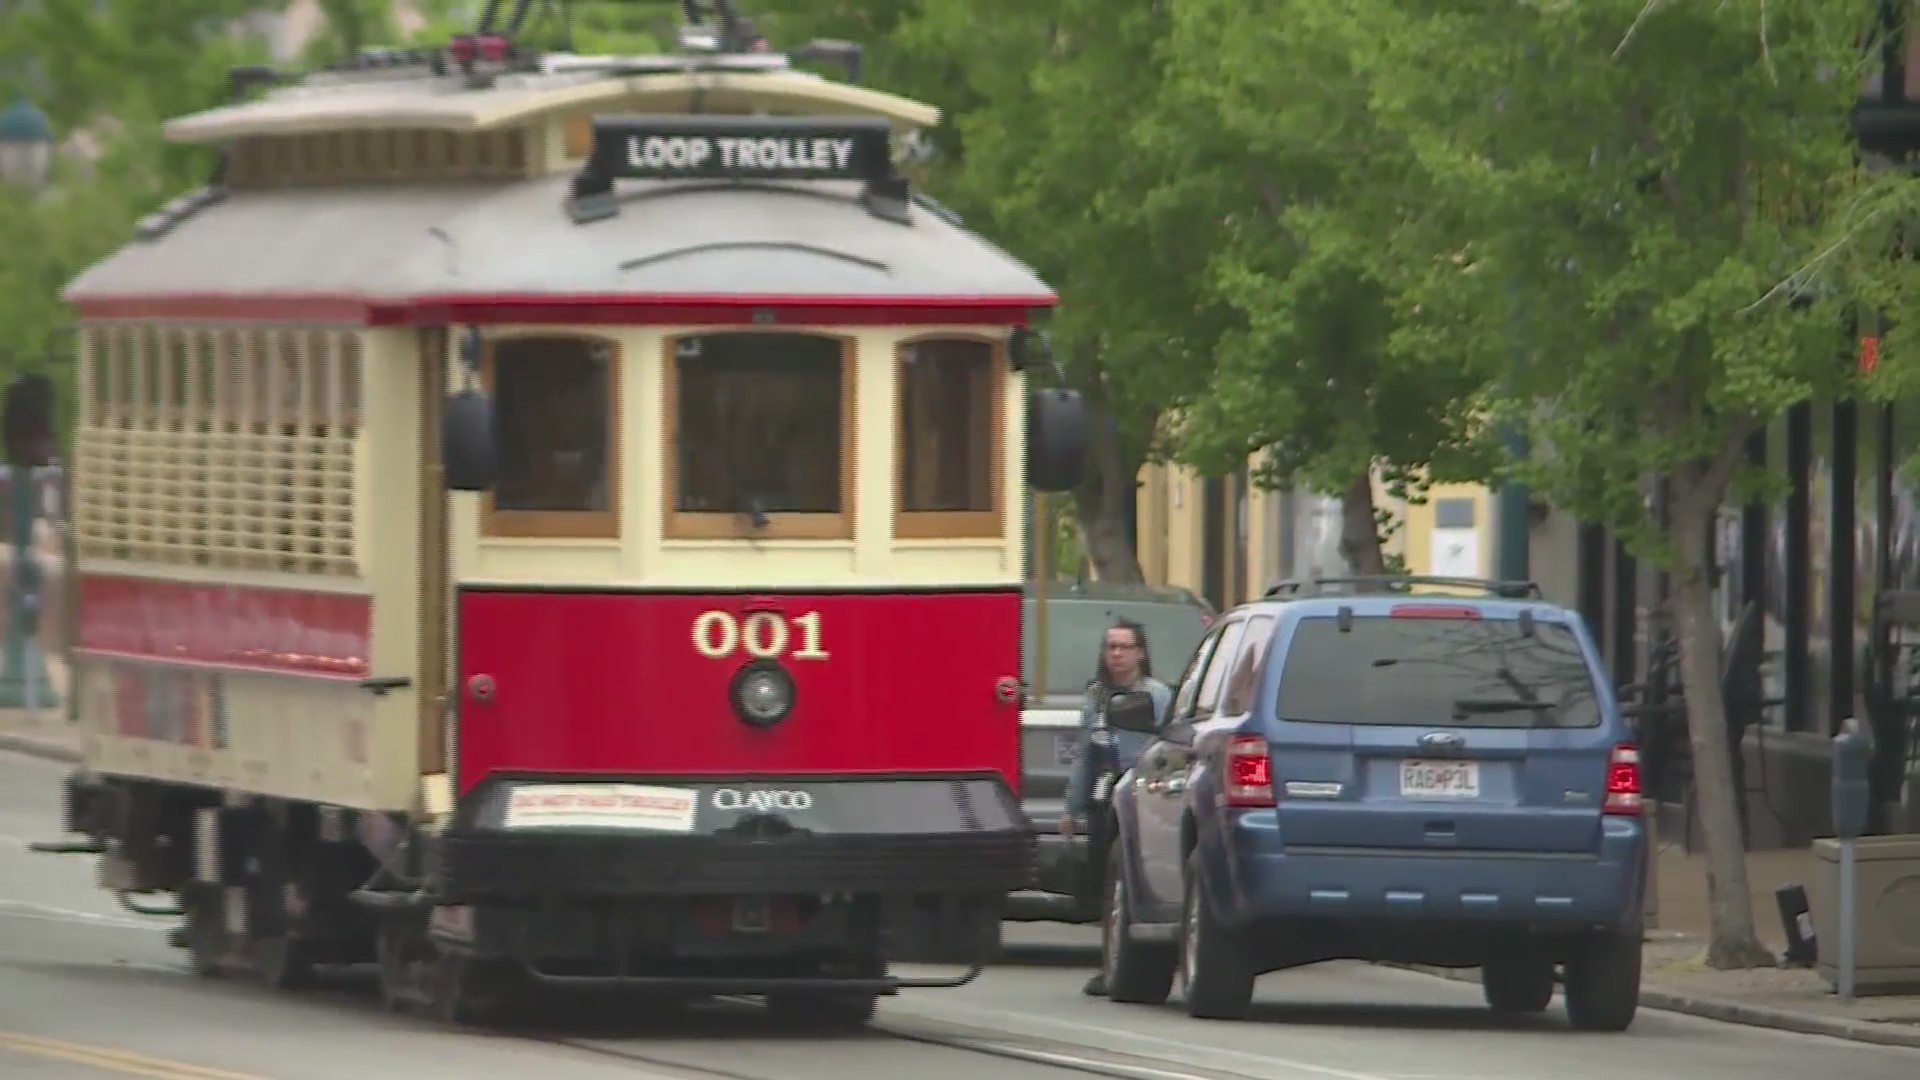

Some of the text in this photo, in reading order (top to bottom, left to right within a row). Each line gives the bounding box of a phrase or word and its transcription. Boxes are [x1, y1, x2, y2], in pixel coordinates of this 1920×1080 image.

[626, 135, 853, 169] LOOP TROLLEY
[691, 610, 831, 661] 001
[712, 788, 812, 811] CLAYCO
